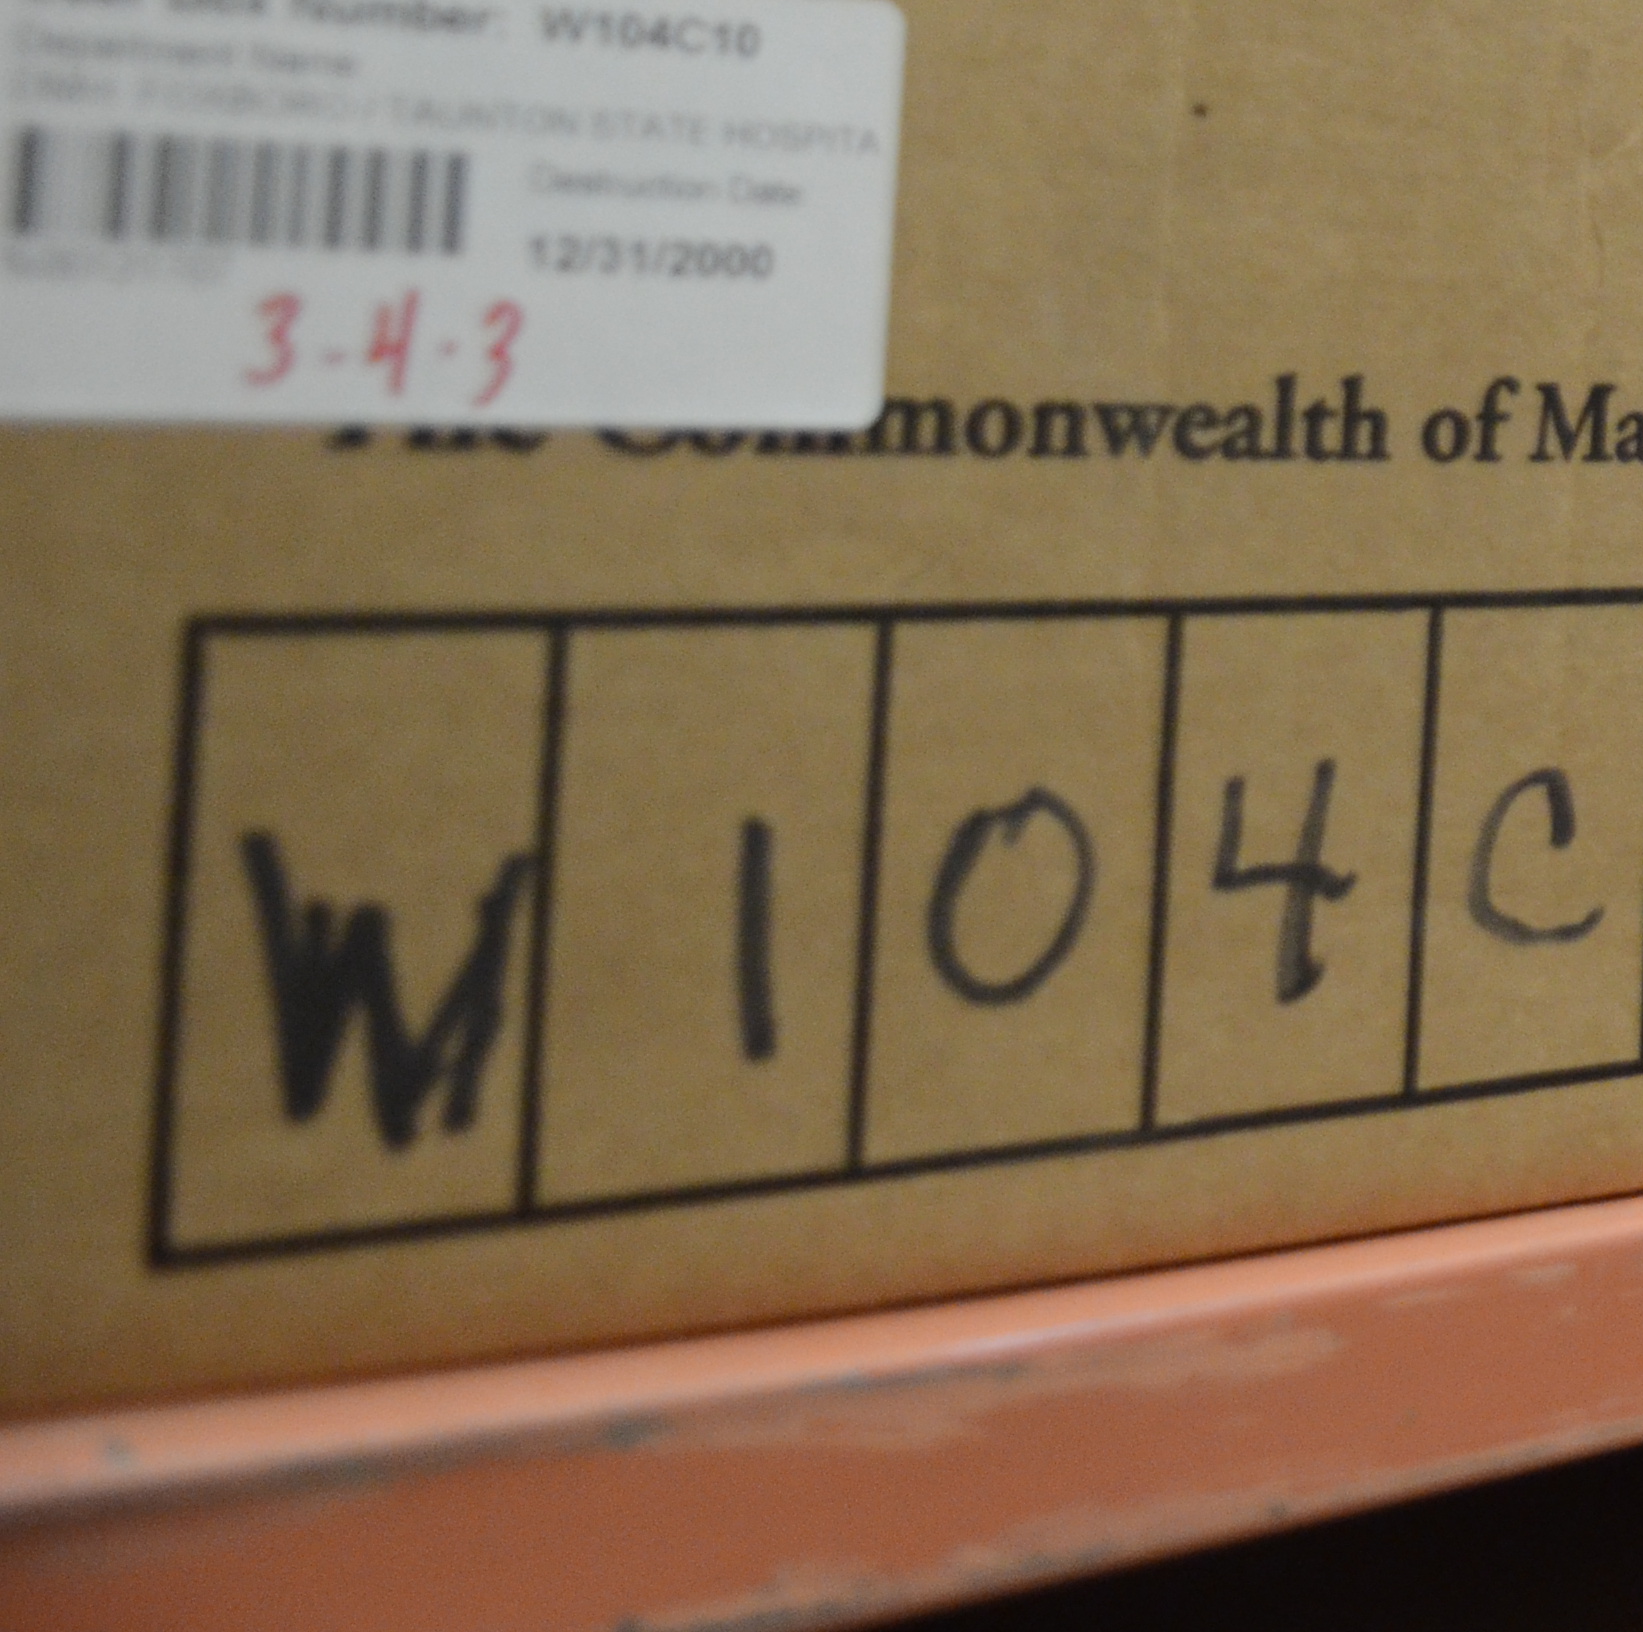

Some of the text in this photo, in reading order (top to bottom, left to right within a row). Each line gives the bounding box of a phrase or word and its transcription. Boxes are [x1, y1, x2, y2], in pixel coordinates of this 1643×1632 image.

[538, 4, 763, 64] W104C10
[527, 232, 775, 282] 12/31/2000
[590, 374, 1391, 462] monwealth
[1420, 374, 1522, 463] of
